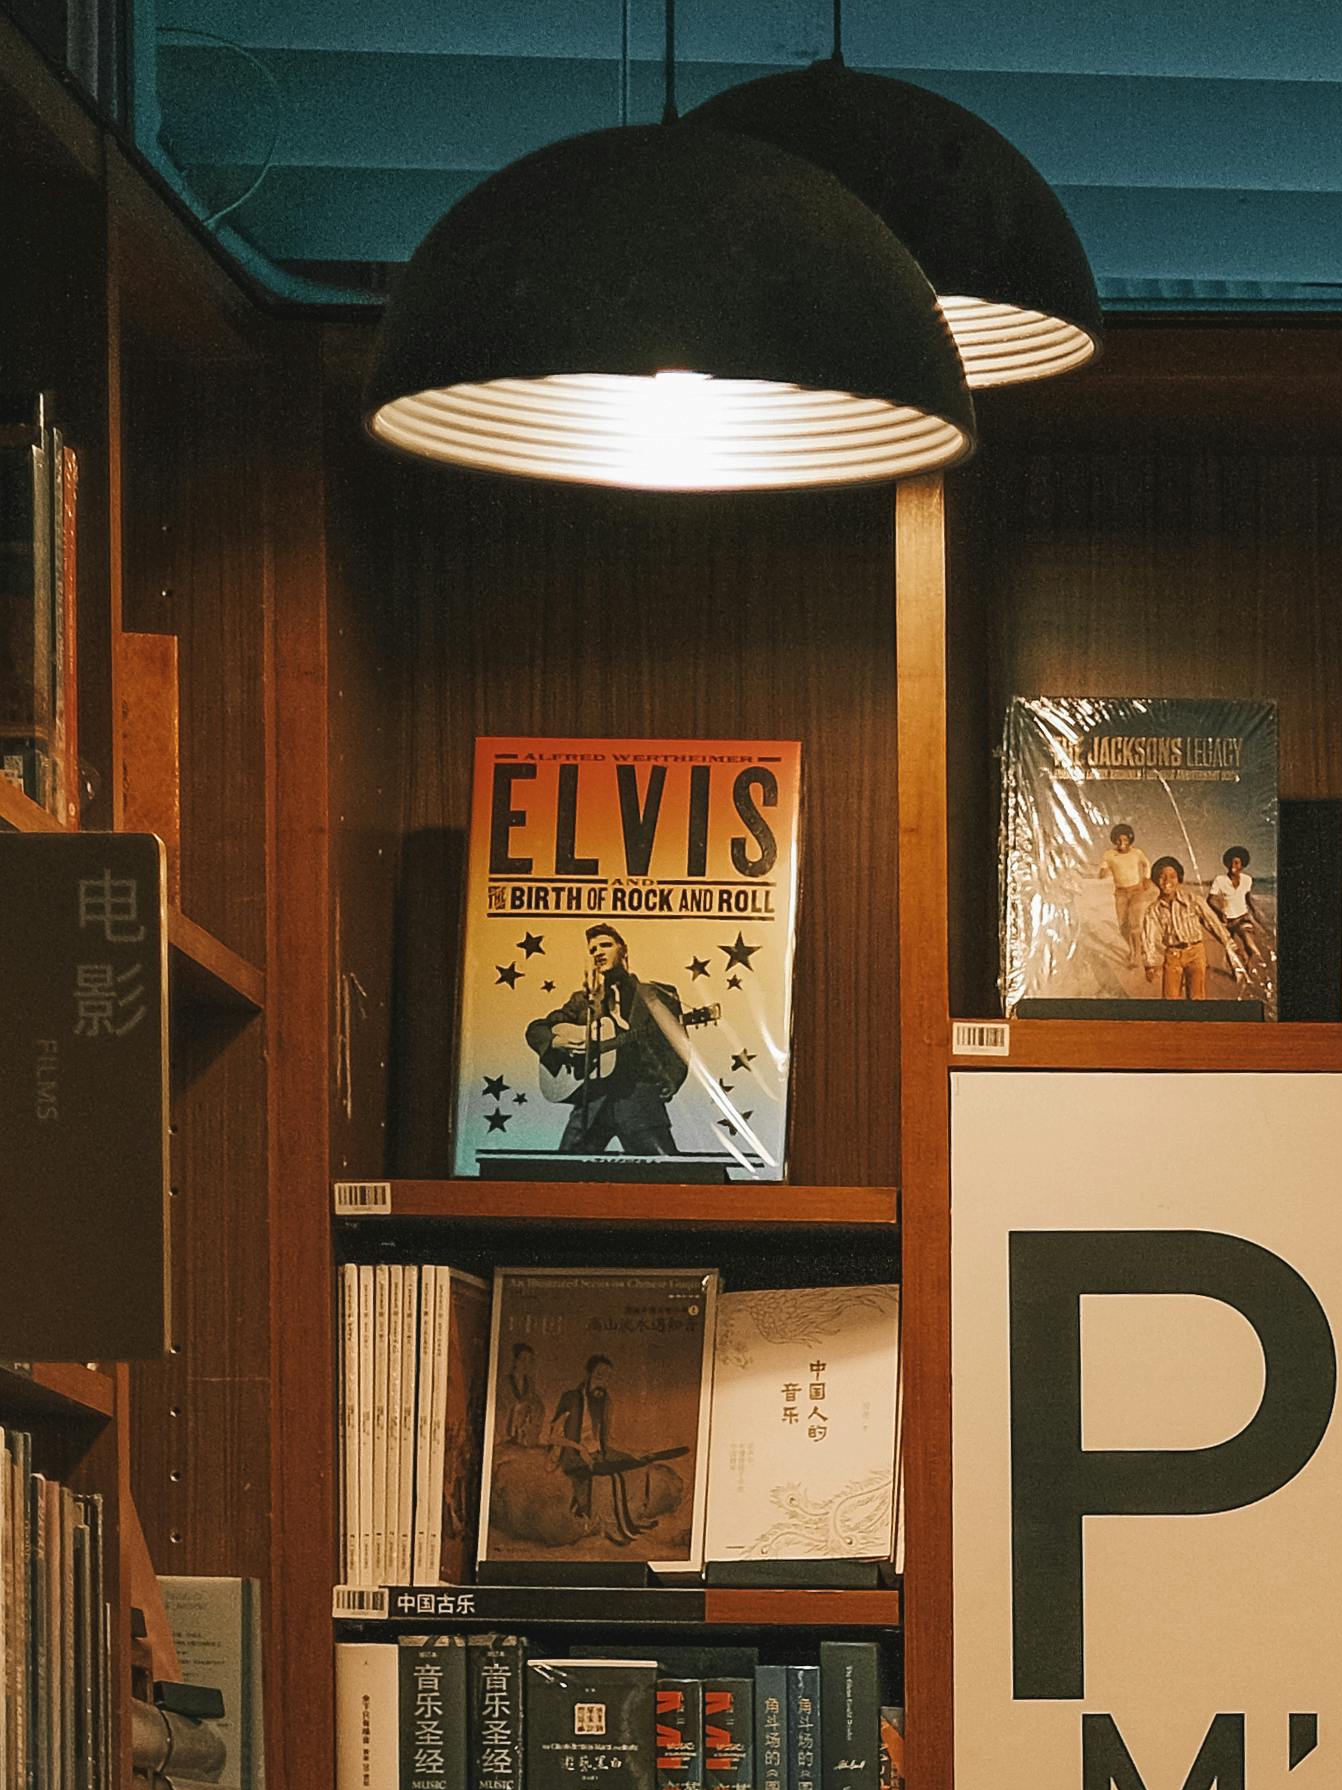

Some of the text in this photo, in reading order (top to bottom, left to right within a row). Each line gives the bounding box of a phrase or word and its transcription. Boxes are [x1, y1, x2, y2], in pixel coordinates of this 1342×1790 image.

[524, 754, 606, 762] ALFRED
[1088, 736, 1243, 767] JACKSONS LEGACY
[489, 763, 778, 877] ELVIS
[511, 886, 582, 910] BIRTH
[587, 887, 608, 911] OF
[612, 887, 673, 912] ROCK
[679, 889, 713, 912] AND
[718, 889, 776, 914] ROLL
[612, 877, 654, 886] AND
[73, 867, 146, 1037] 电影
[36, 1039, 57, 1120] FILMS
[781, 1382, 802, 1424] 音乐
[808, 1359, 829, 1442] 中国人的
[397, 1594, 476, 1615] 中国古乐
[413, 1664, 445, 1774] 音乐圣经
[482, 1664, 513, 1774] 音乐圣经
[411, 1780, 447, 1790] MUSIC
